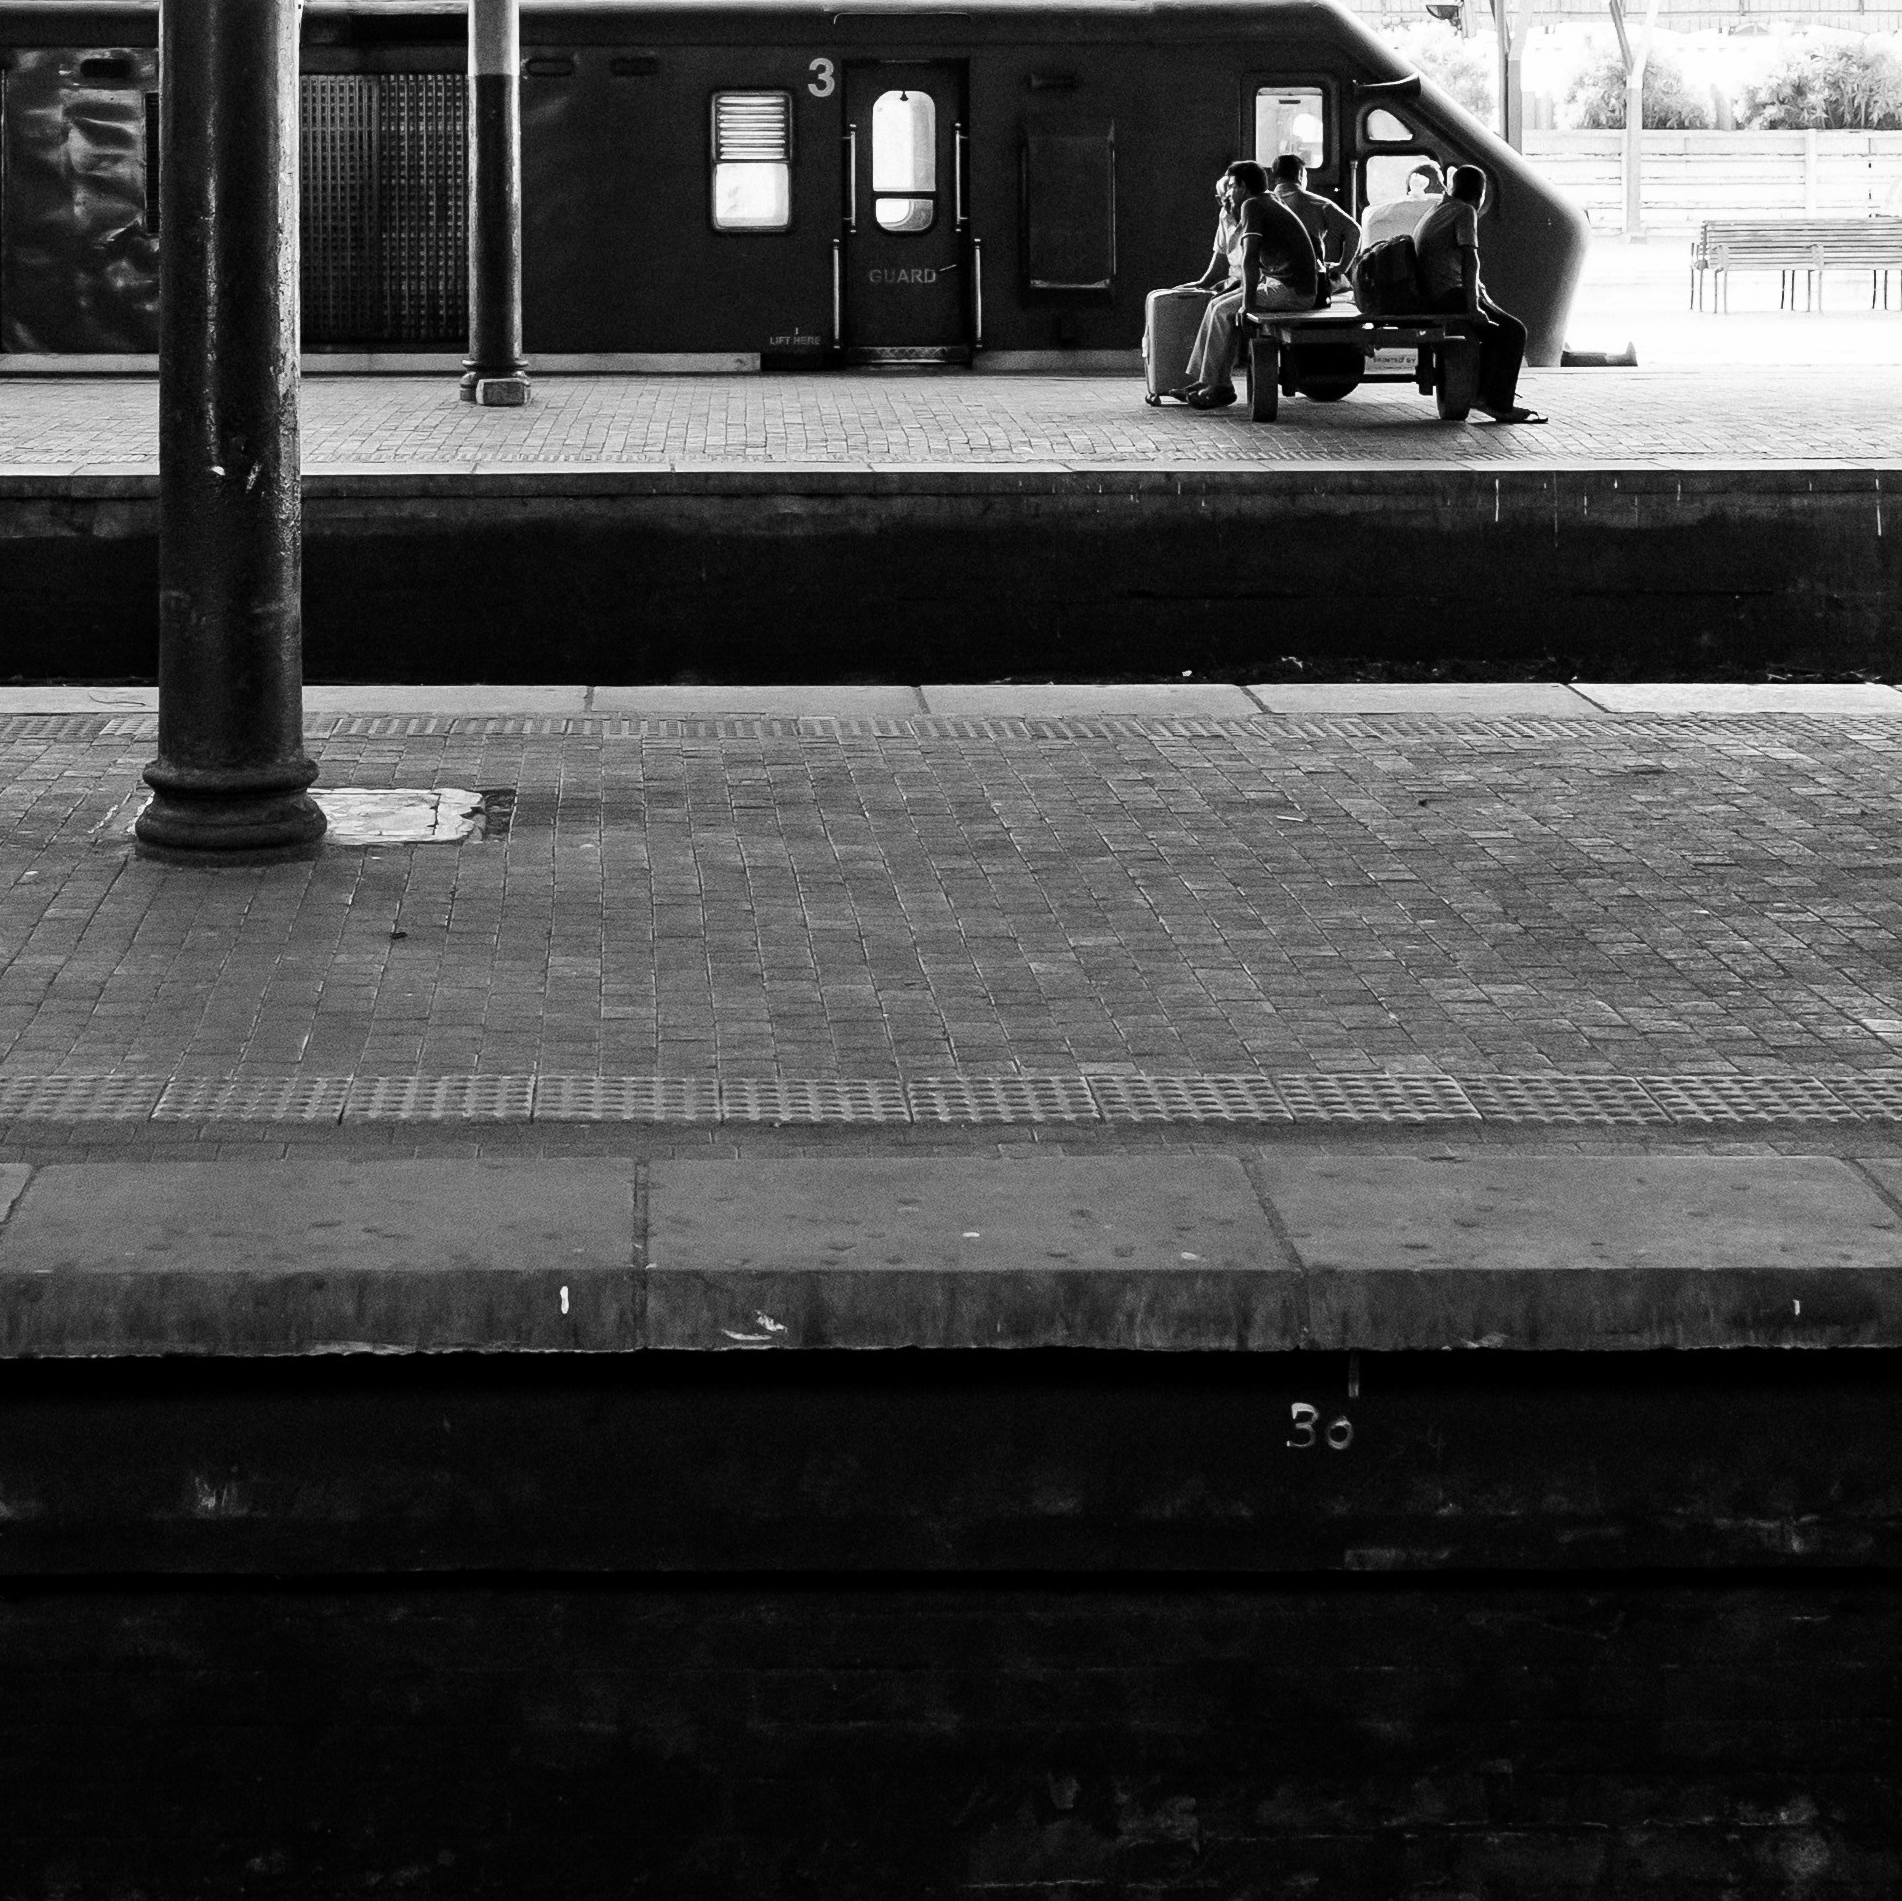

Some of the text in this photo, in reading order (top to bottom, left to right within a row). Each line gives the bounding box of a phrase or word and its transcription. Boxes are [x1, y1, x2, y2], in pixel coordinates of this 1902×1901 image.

[807, 58, 835, 97] 3
[869, 268, 937, 283] GUARD
[769, 336, 821, 345] LIFT HERE
[1285, 1401, 1354, 1450] 30
